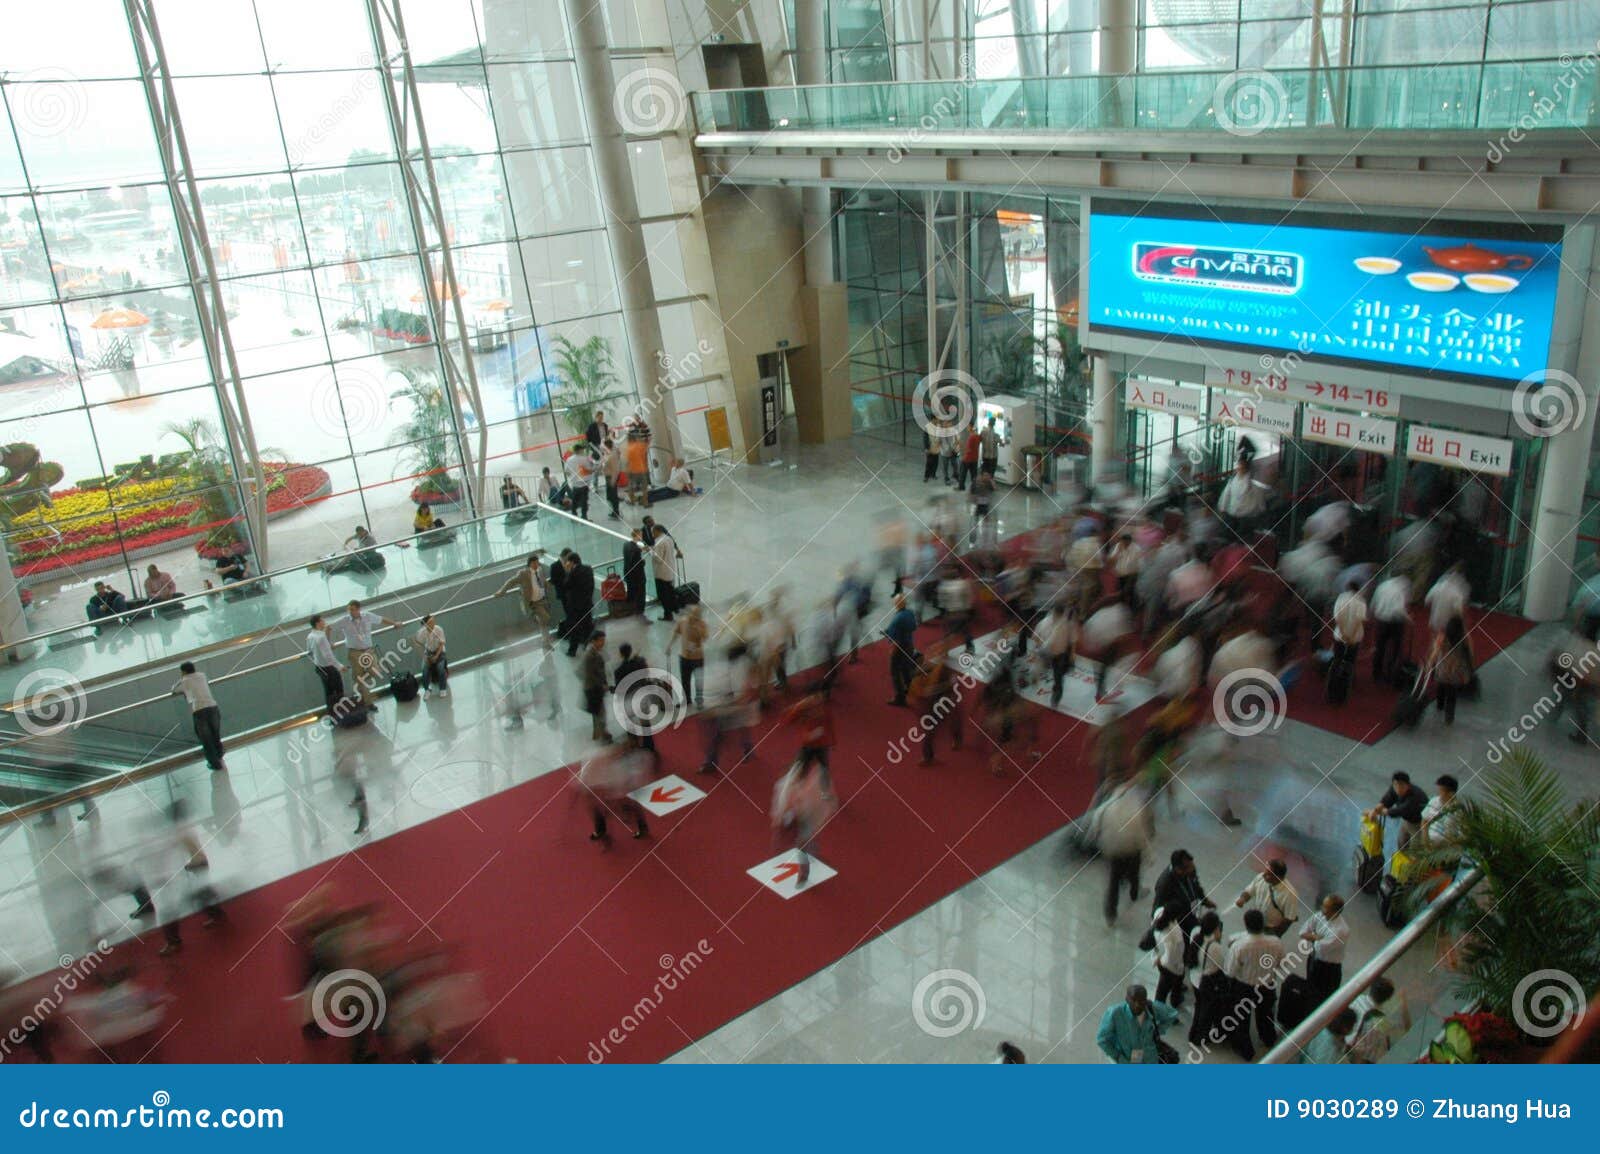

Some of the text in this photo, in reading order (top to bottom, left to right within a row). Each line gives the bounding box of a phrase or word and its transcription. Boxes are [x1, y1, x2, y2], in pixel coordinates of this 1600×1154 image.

[1104, 307, 1176, 325] FAMOUS
[1183, 316, 1250, 337] BRAND
[1256, 326, 1279, 337] OF
[1404, 344, 1430, 356] IN
[1439, 349, 1520, 368] CHINA
[1131, 387, 1197, 411] 入口 Entrance
[1328, 383, 1389, 408] 14-16
[1218, 401, 1290, 429] 入口 Entrance
[1310, 415, 1386, 446] 出口 Exit
[1416, 434, 1501, 466] 出口 Exit
